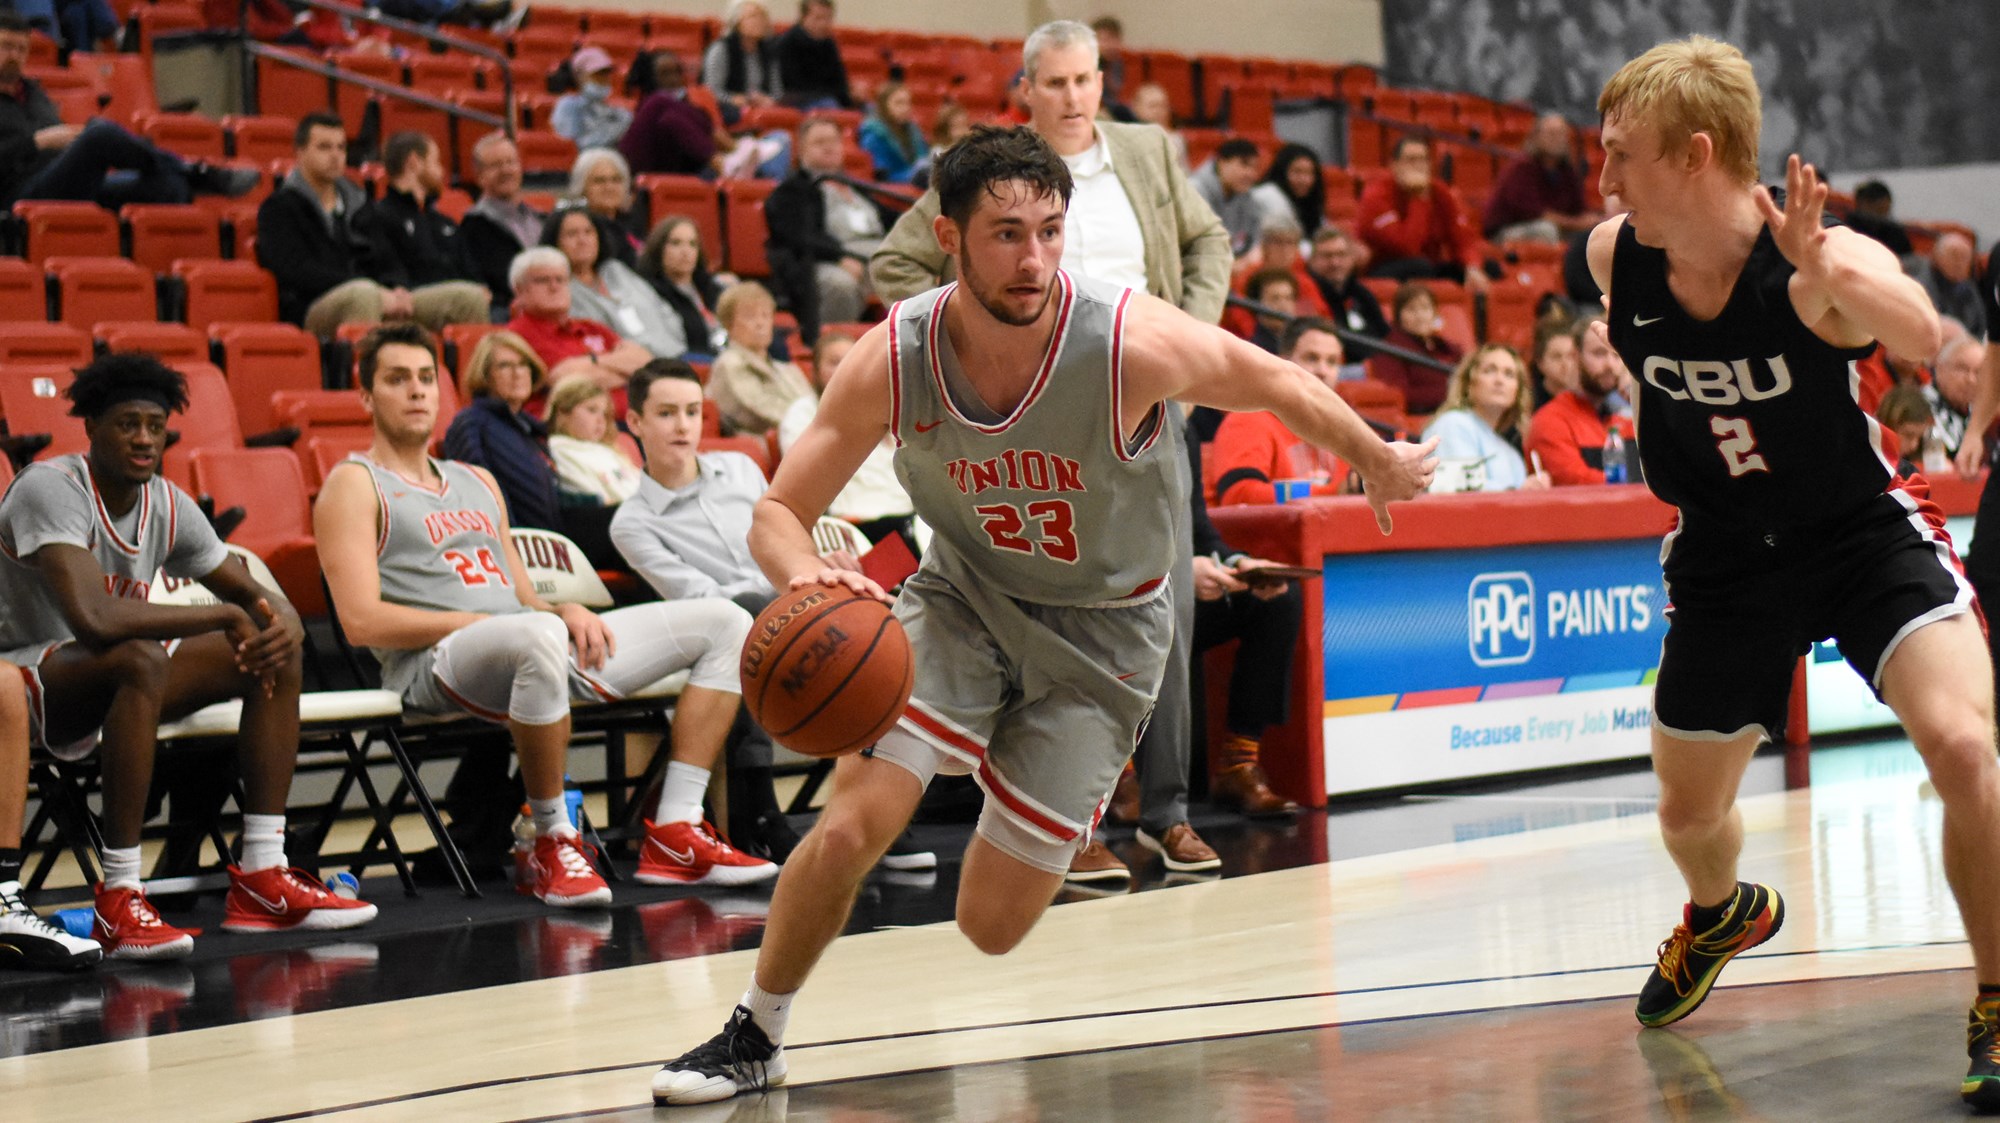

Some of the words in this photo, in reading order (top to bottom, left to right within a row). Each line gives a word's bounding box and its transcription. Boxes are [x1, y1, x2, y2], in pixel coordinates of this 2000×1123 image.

[1643, 353, 1793, 406] CBU
[945, 448, 1088, 495] UNION
[1710, 415, 1771, 479] 2
[973, 498, 1080, 565] 23
[442, 547, 510, 588] 24
[1474, 584, 1530, 654] PPG
[1548, 585, 1650, 638] PAINTS
[781, 624, 848, 697] NCAA
[1451, 724, 1522, 750] Because
[1527, 716, 1575, 742] Every
[1580, 712, 1608, 735] Job
